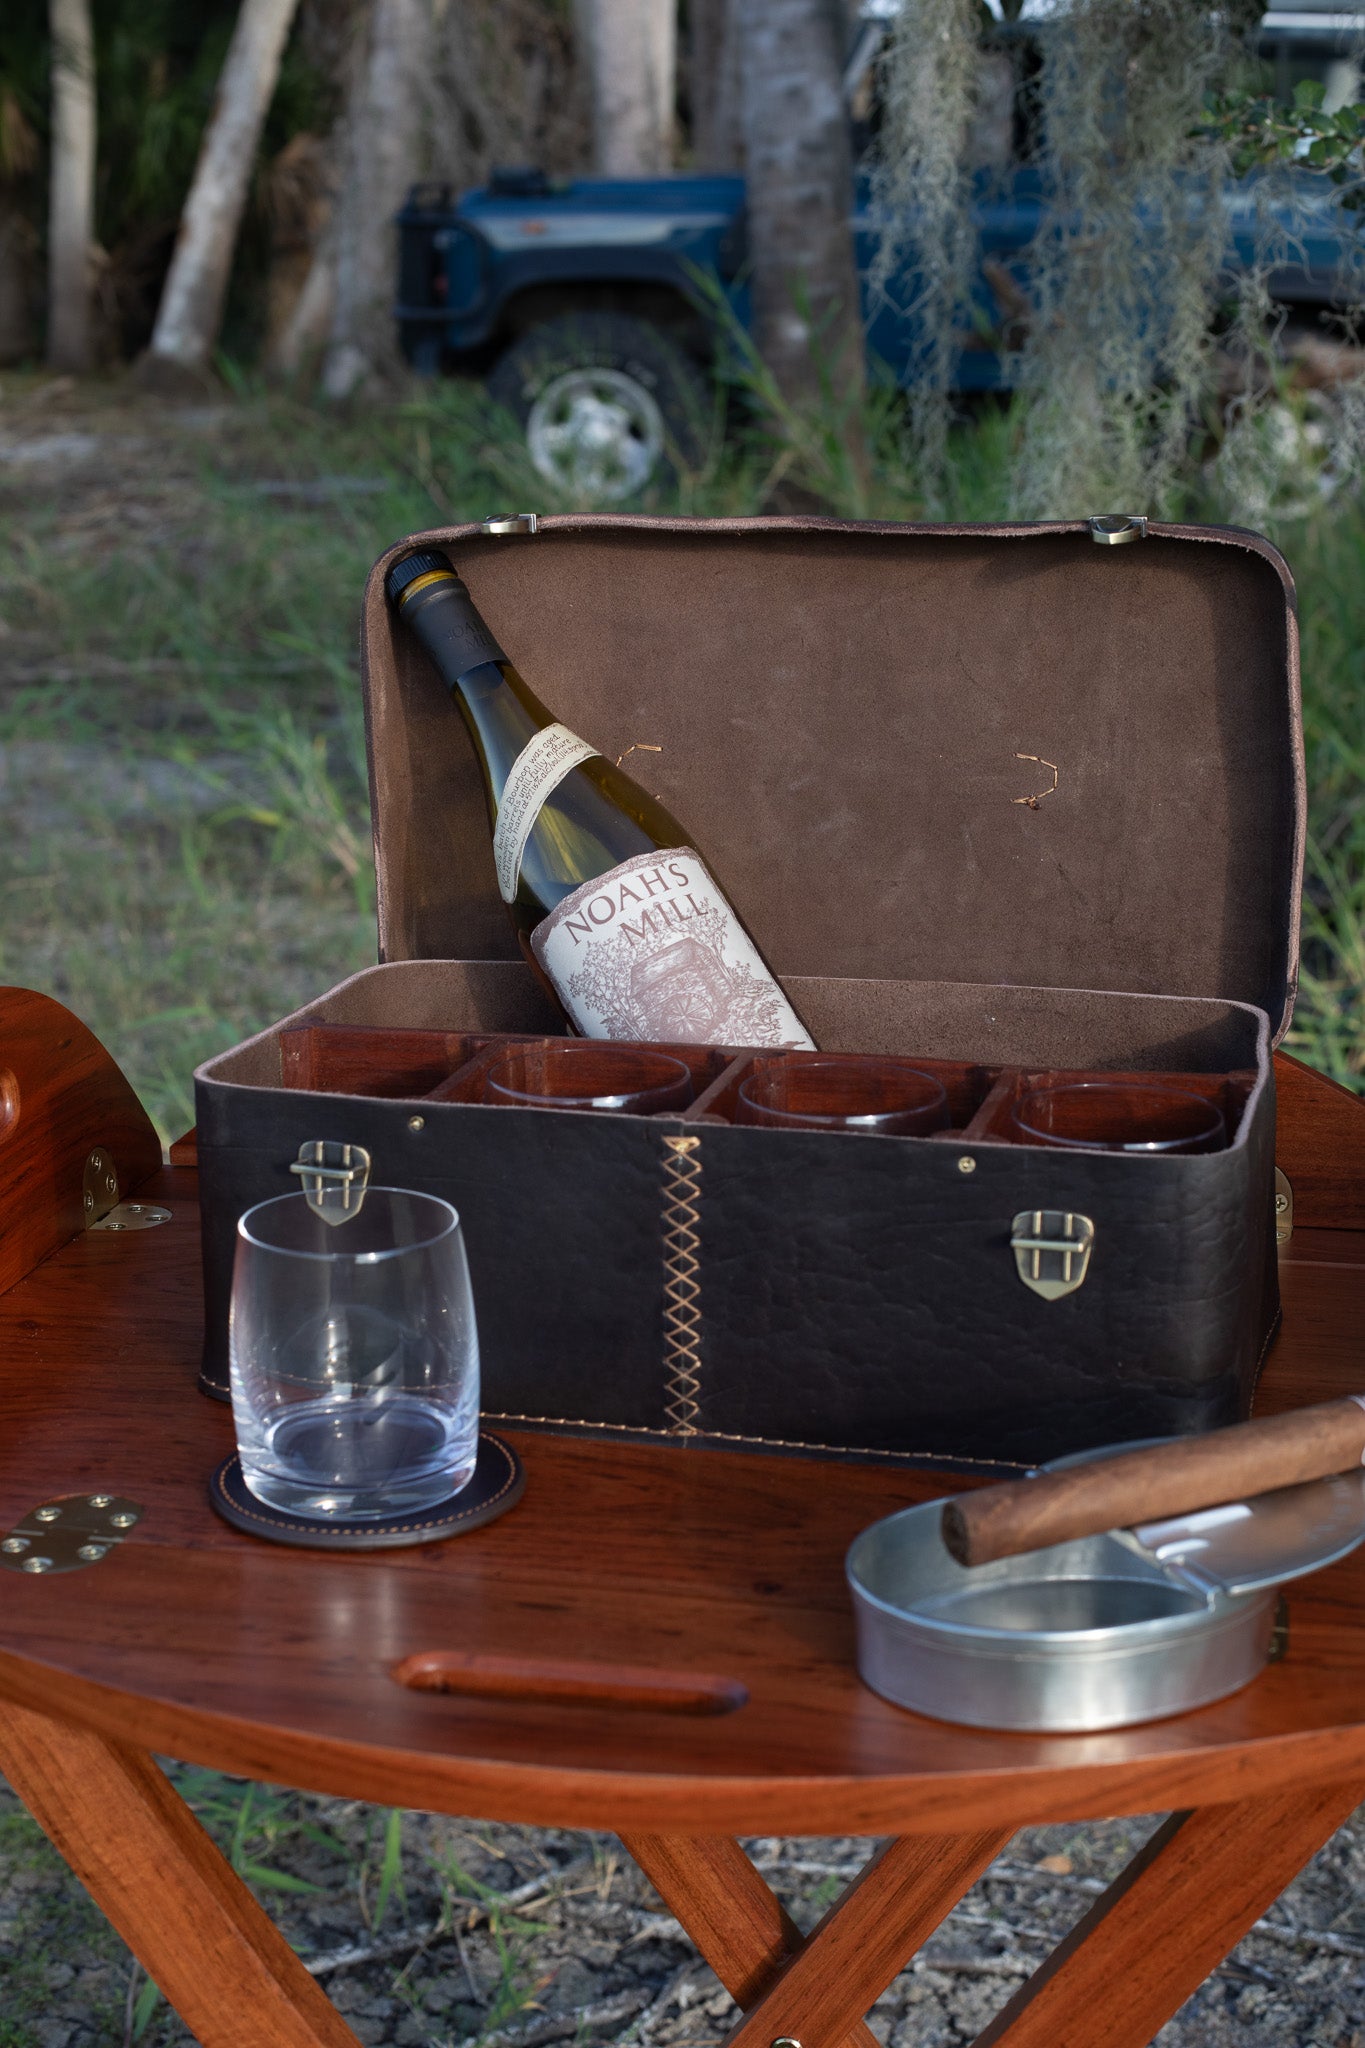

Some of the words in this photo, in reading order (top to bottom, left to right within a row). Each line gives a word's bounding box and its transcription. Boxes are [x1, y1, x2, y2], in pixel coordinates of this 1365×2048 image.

[506, 765, 531, 806] Bourbon
[529, 749, 544, 765] was
[519, 777, 532, 799] until
[528, 759, 548, 779] fully
[546, 738, 571, 758] mature
[509, 836, 518, 849] by
[514, 810, 525, 834] hand
[563, 862, 689, 946] NOAH'S
[617, 892, 709, 947] MILL
